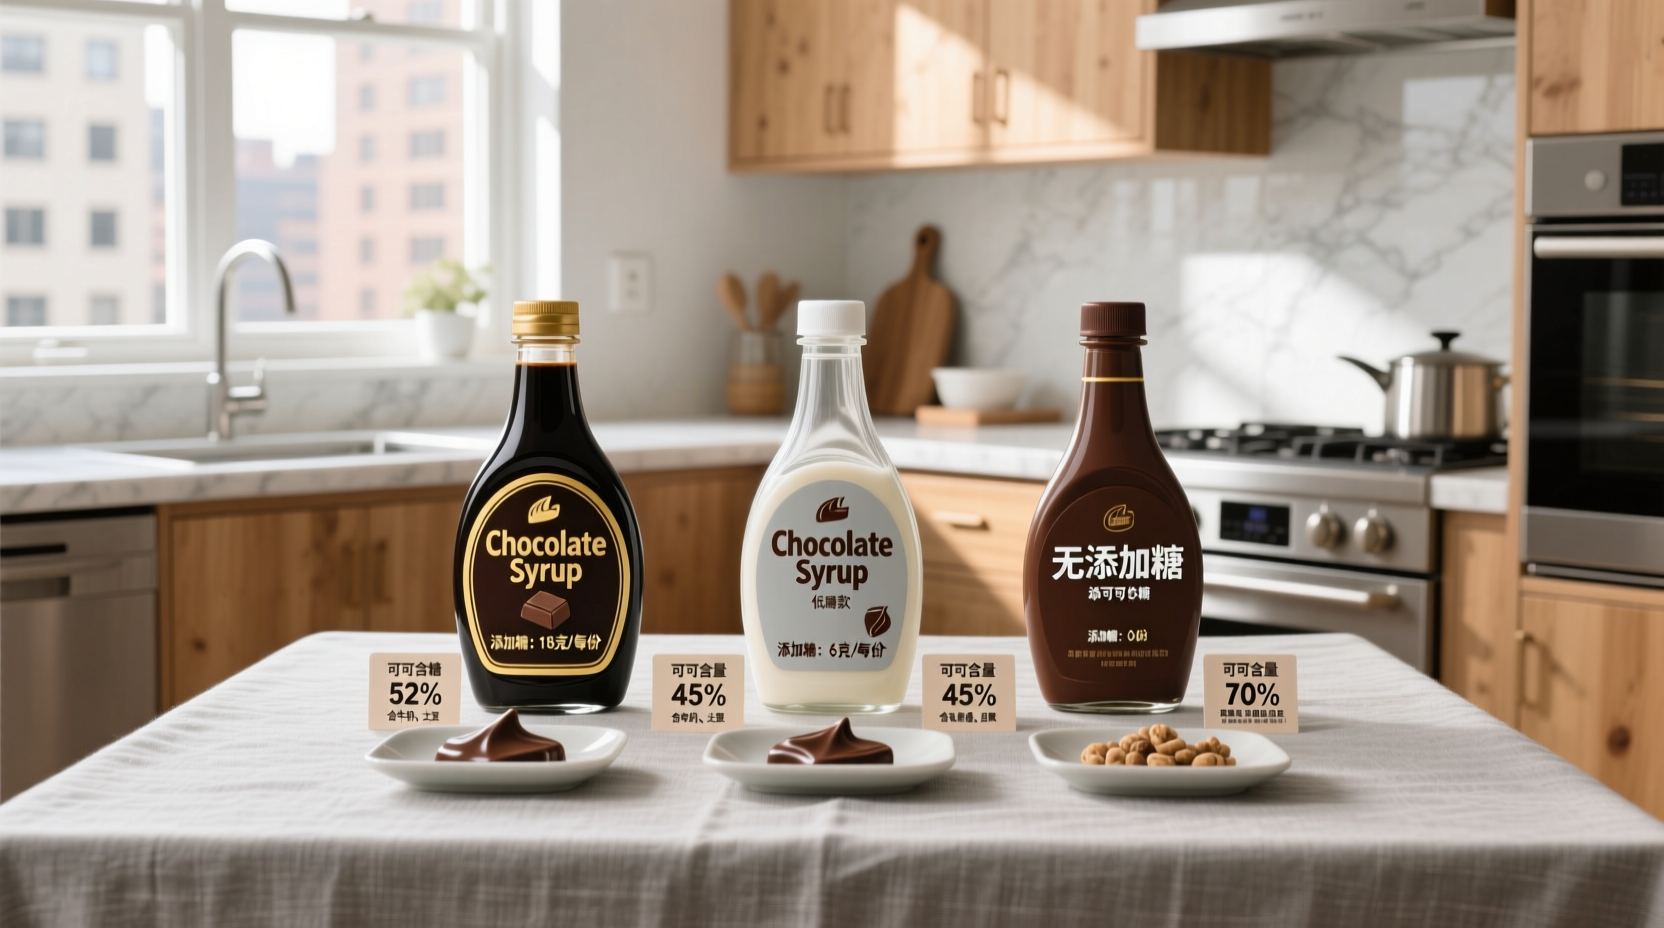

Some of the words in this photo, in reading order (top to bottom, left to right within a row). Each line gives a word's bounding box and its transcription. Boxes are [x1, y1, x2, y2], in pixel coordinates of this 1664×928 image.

[486, 529, 607, 557] Chocolate
[771, 530, 893, 557] Chocolate
[510, 558, 583, 590] Syrup
[1052, 544, 1184, 580] 无添加糖
[796, 560, 868, 590] Syrup
[671, 662, 727, 678] 可可含量
[940, 662, 996, 678] 可可含量
[1223, 661, 1279, 677] 可可含量
[389, 681, 442, 706] 52%
[671, 683, 726, 707] 45%
[942, 683, 997, 707] 45%
[1226, 682, 1280, 706] 70%
